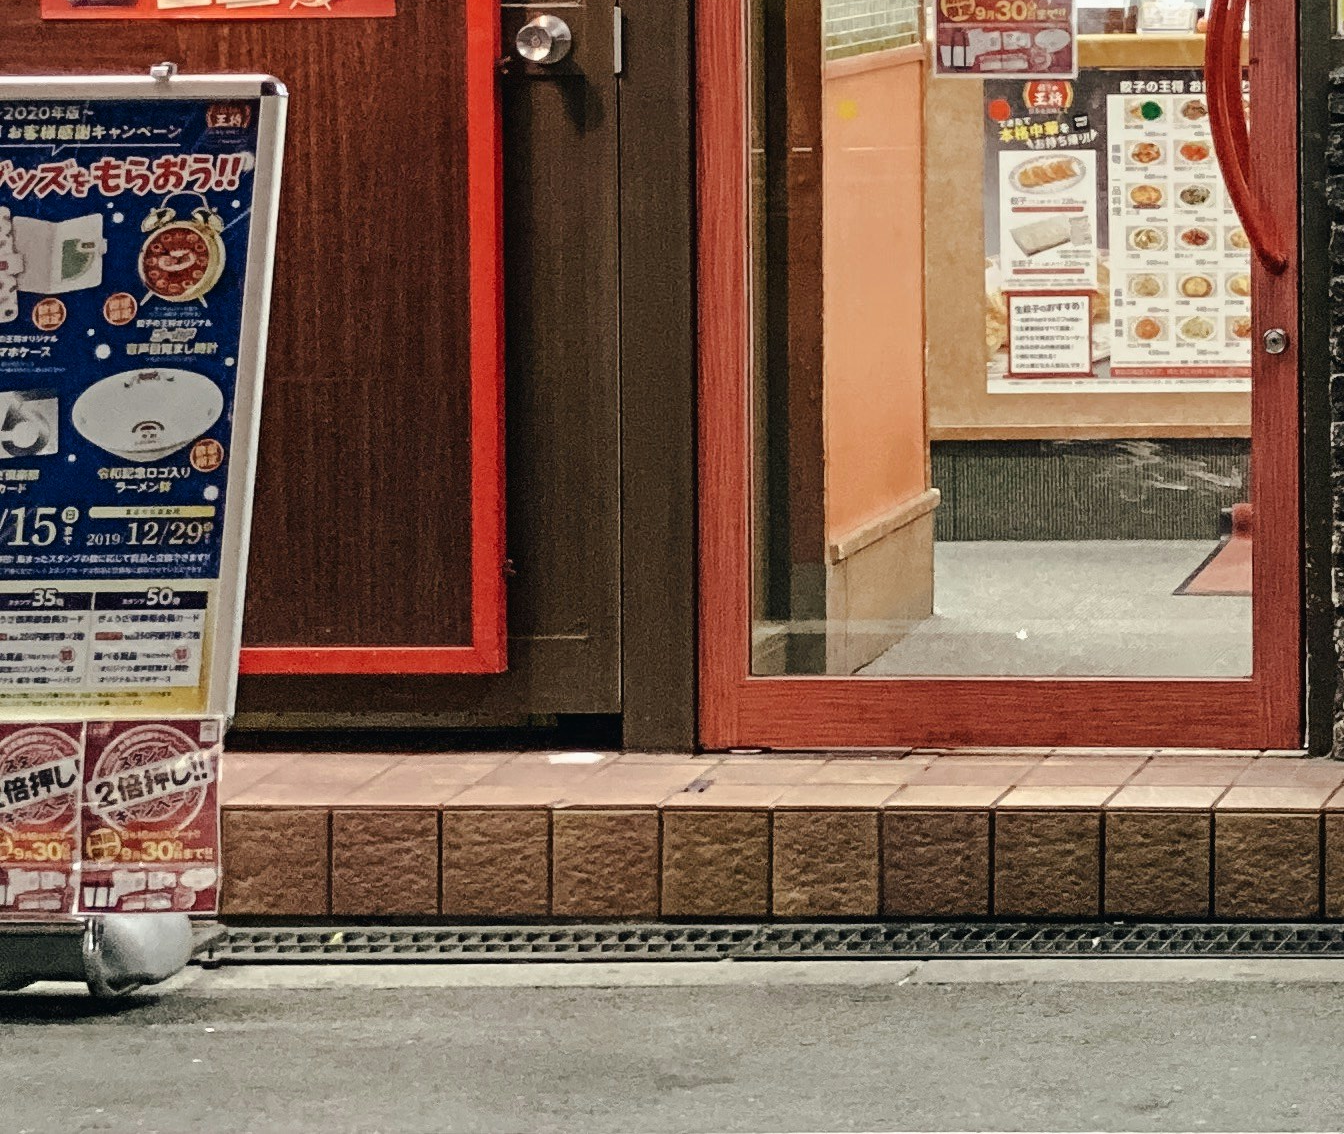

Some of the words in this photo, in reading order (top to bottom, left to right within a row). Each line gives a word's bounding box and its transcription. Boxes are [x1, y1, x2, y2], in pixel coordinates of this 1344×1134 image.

[1120, 80, 1185, 94] 餃子の王将
[1033, 91, 1063, 106] 王将
[0, 154, 244, 200] ッズをもらおう!!
[86, 533, 121, 546] 2019
[125, 521, 203, 546] 12/29
